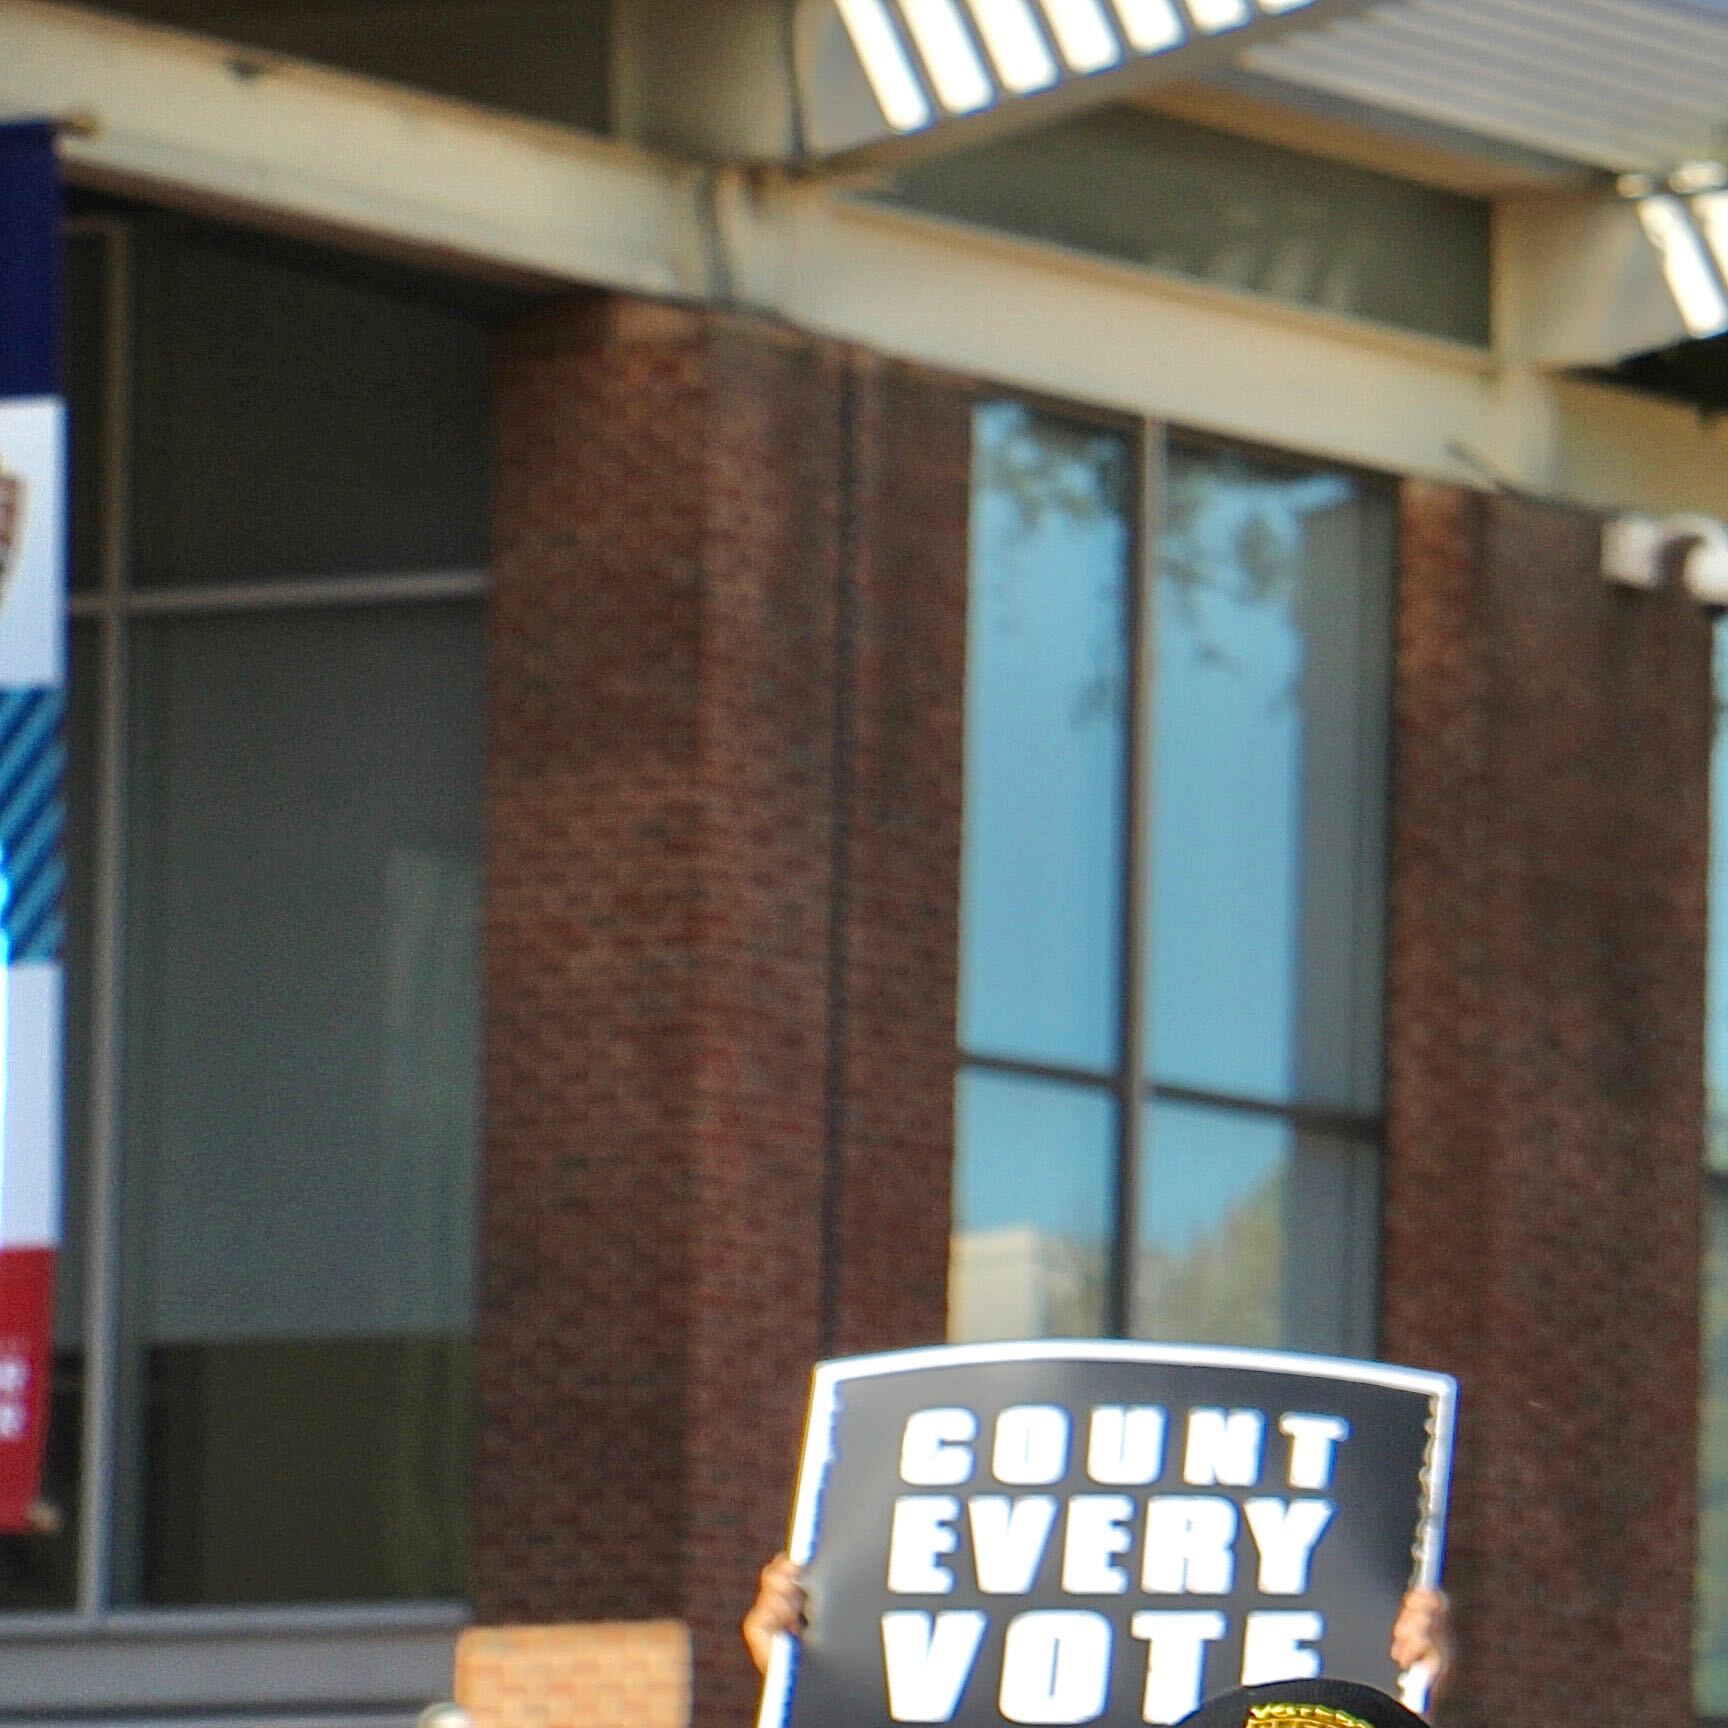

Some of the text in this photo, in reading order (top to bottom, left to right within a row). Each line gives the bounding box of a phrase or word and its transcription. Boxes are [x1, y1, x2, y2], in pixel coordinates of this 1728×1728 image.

[900, 1403, 1350, 1490] COUNT
[886, 1494, 1337, 1596] EVERY
[880, 1610, 1325, 1726] VOTE
